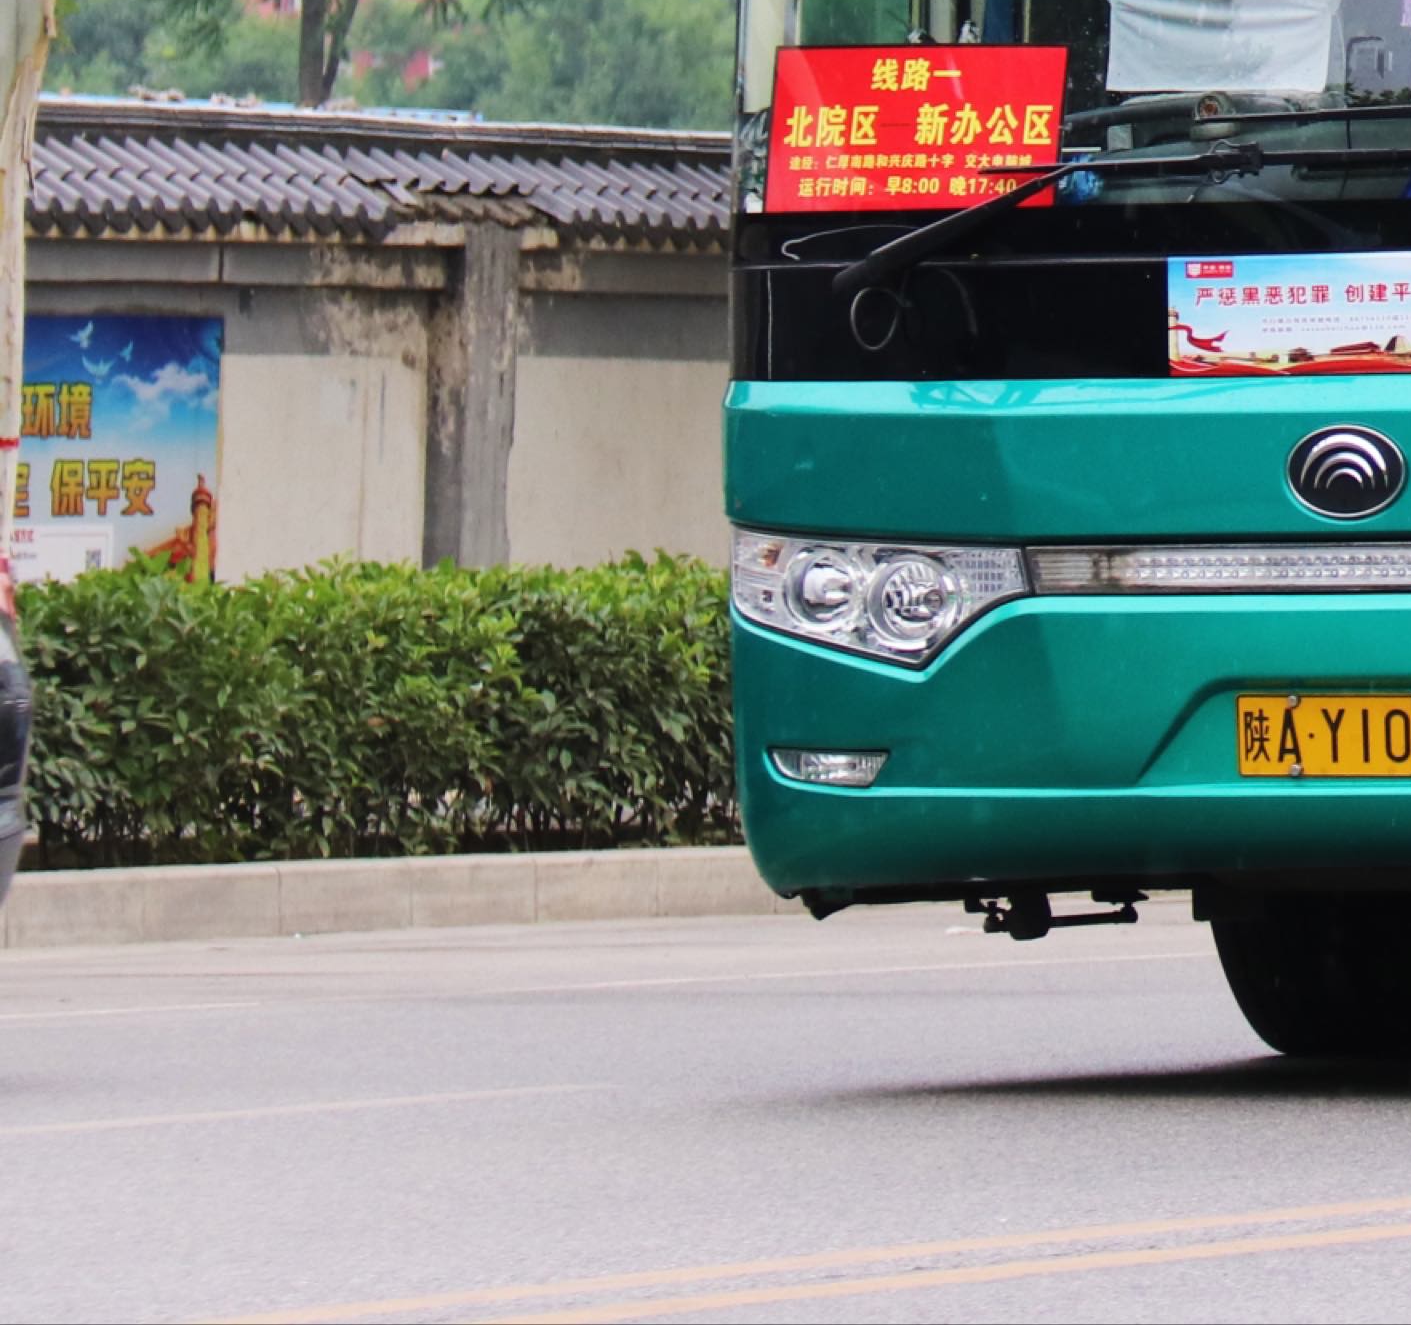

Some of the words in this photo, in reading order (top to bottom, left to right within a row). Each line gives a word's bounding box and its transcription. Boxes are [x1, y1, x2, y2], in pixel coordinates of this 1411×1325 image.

[871, 59, 962, 92] 线路一
[783, 105, 880, 148] 北院区
[914, 103, 1055, 146] 新办公区
[1194, 284, 1332, 308] 严惩黑恶犯罪
[21, 382, 93, 439] 环境
[50, 458, 156, 517] 保平安
